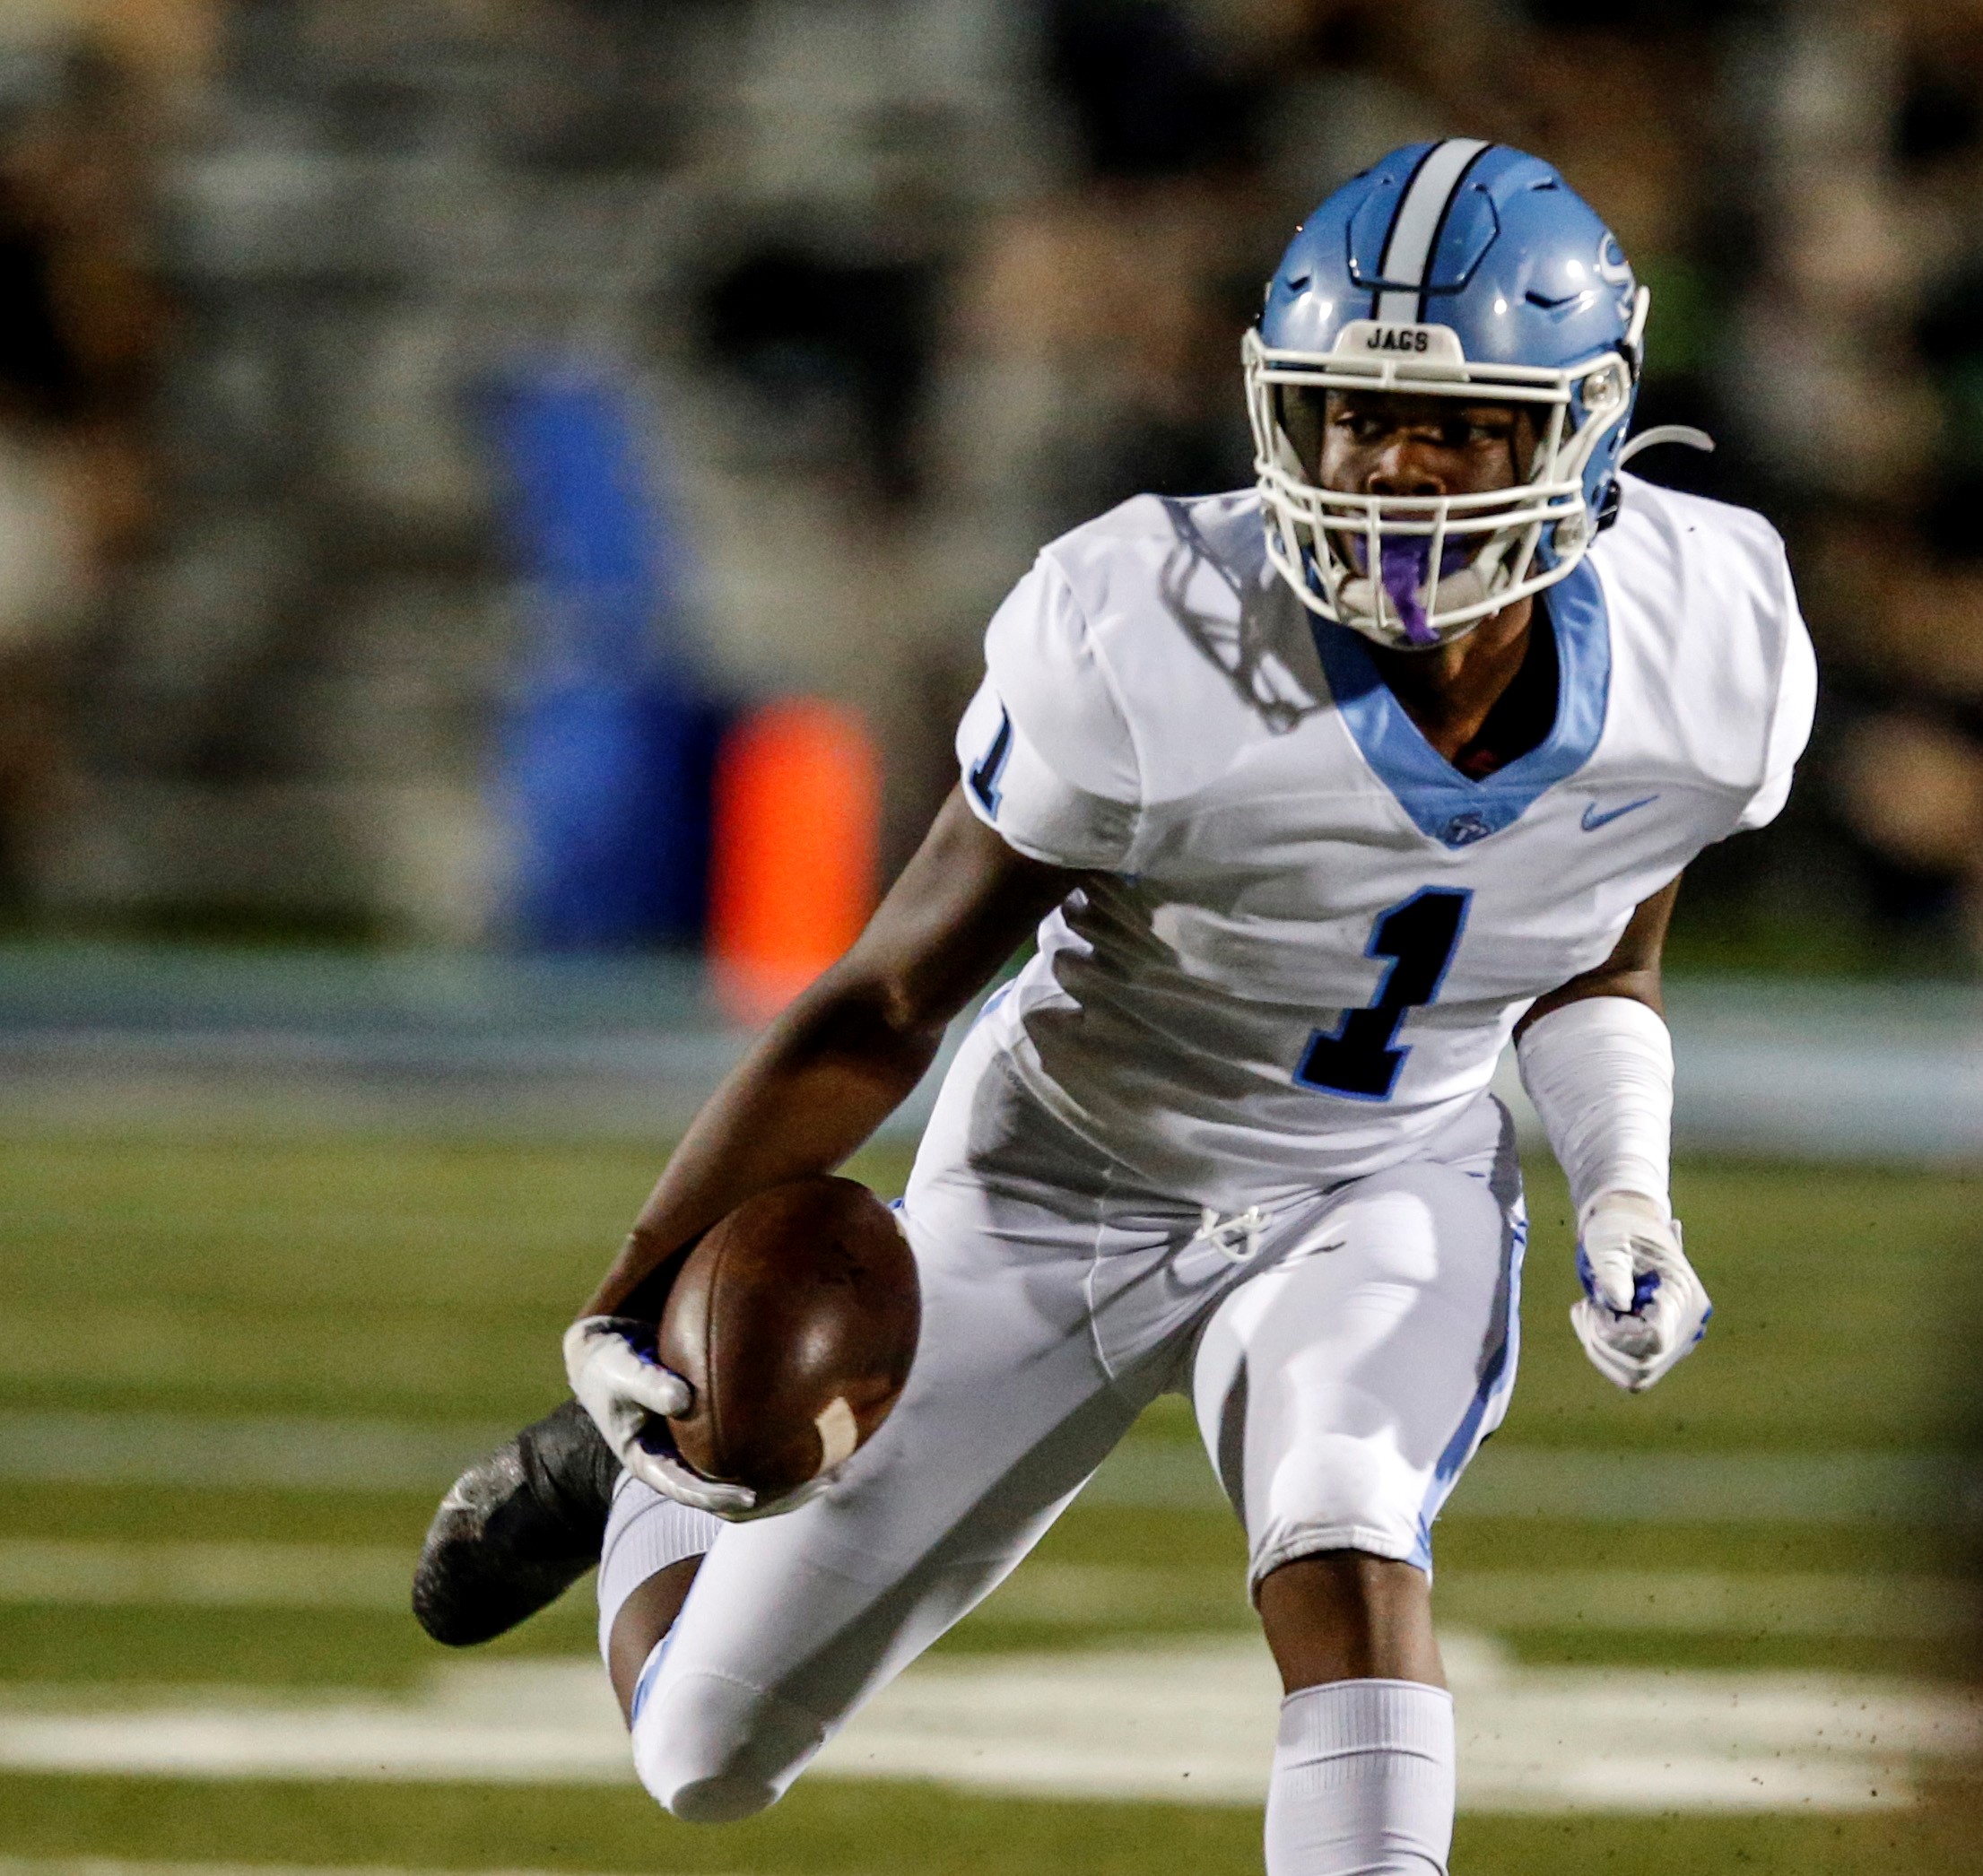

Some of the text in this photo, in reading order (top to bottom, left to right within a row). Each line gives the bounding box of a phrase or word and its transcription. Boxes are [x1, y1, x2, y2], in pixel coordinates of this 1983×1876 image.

[1367, 327, 1428, 352] JAGS
[970, 699, 1014, 822] 1
[1292, 884, 1474, 1102] 1
